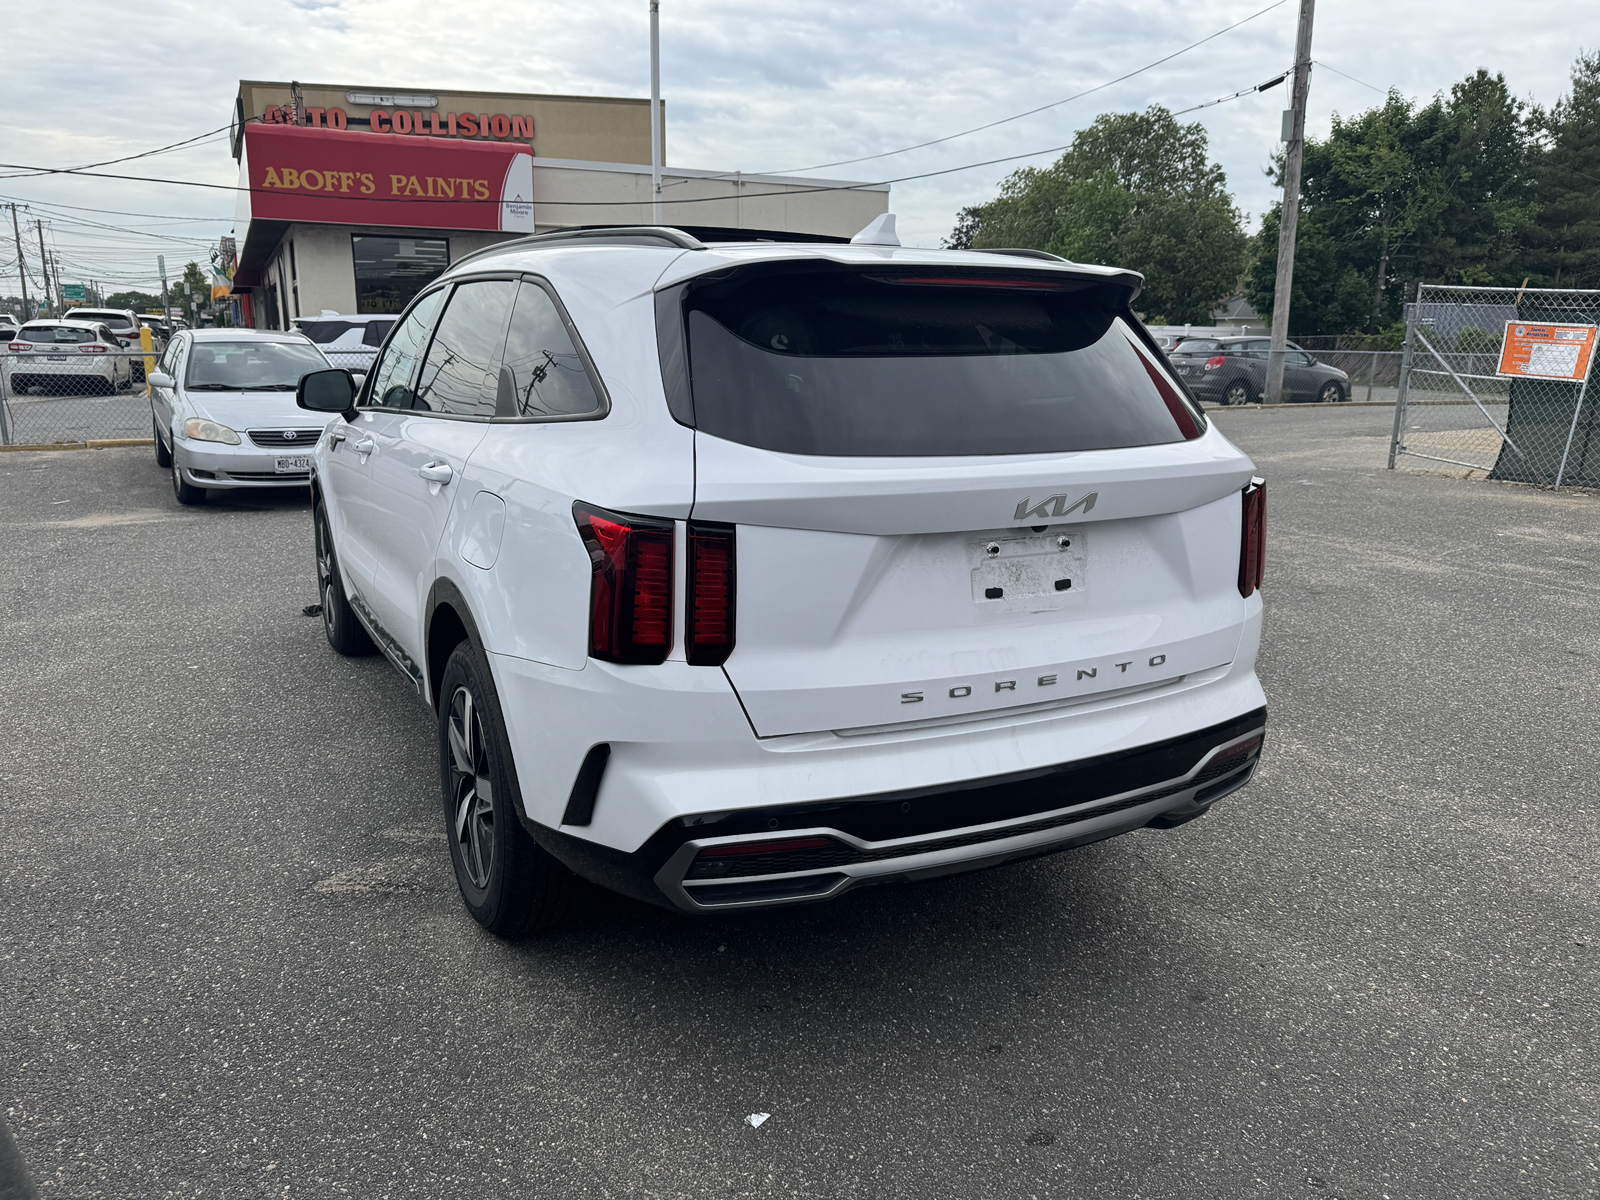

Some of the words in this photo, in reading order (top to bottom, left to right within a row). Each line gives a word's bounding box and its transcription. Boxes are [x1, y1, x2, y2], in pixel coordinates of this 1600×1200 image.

[369, 109, 534, 138] COLLISION
[262, 166, 376, 194] ABOFF'S
[389, 174, 491, 200] PAINTS
[1014, 491, 1098, 520] KIA
[900, 654, 1166, 704] SORENTO
